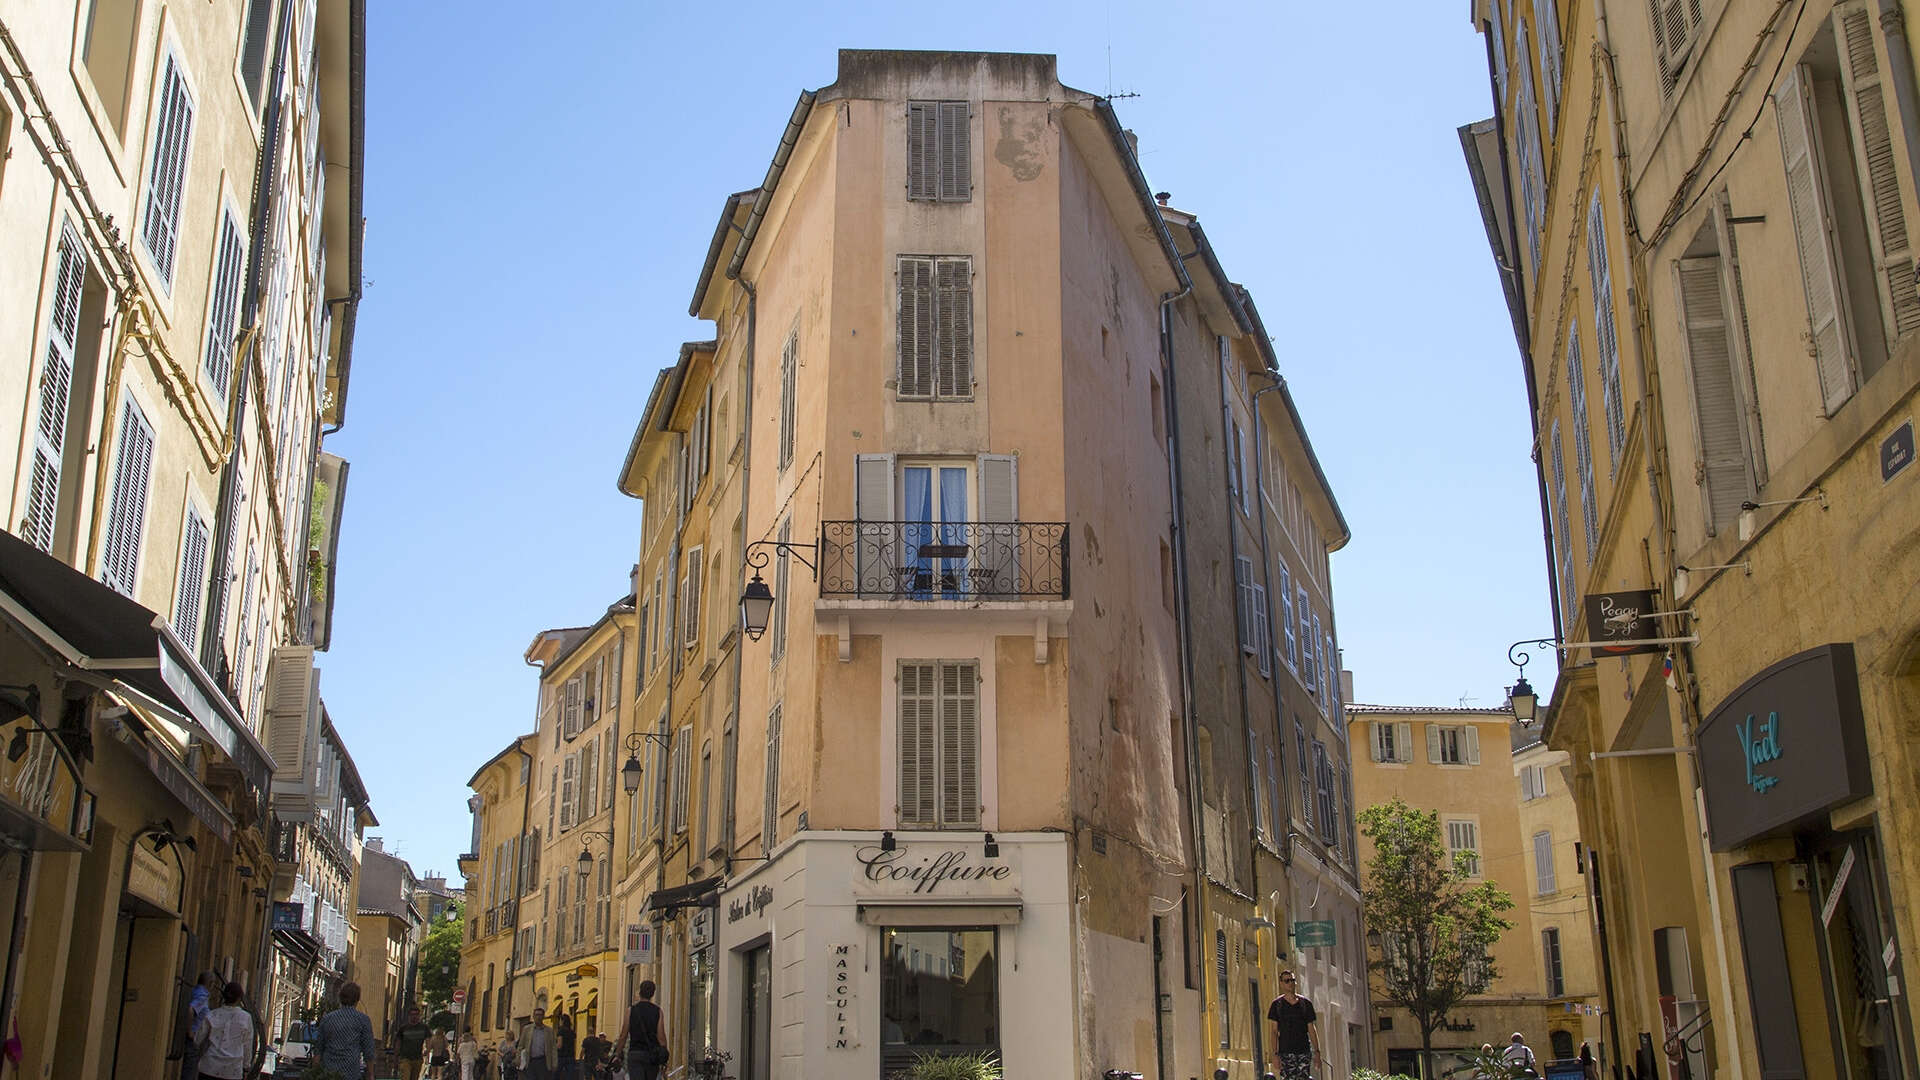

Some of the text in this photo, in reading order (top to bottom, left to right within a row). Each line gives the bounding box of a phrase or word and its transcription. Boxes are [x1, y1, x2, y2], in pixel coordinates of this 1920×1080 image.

[1736, 712, 1782, 785] Yaël
[856, 846, 1011, 894] Coiffure
[834, 944, 849, 1050] MASCULIN
